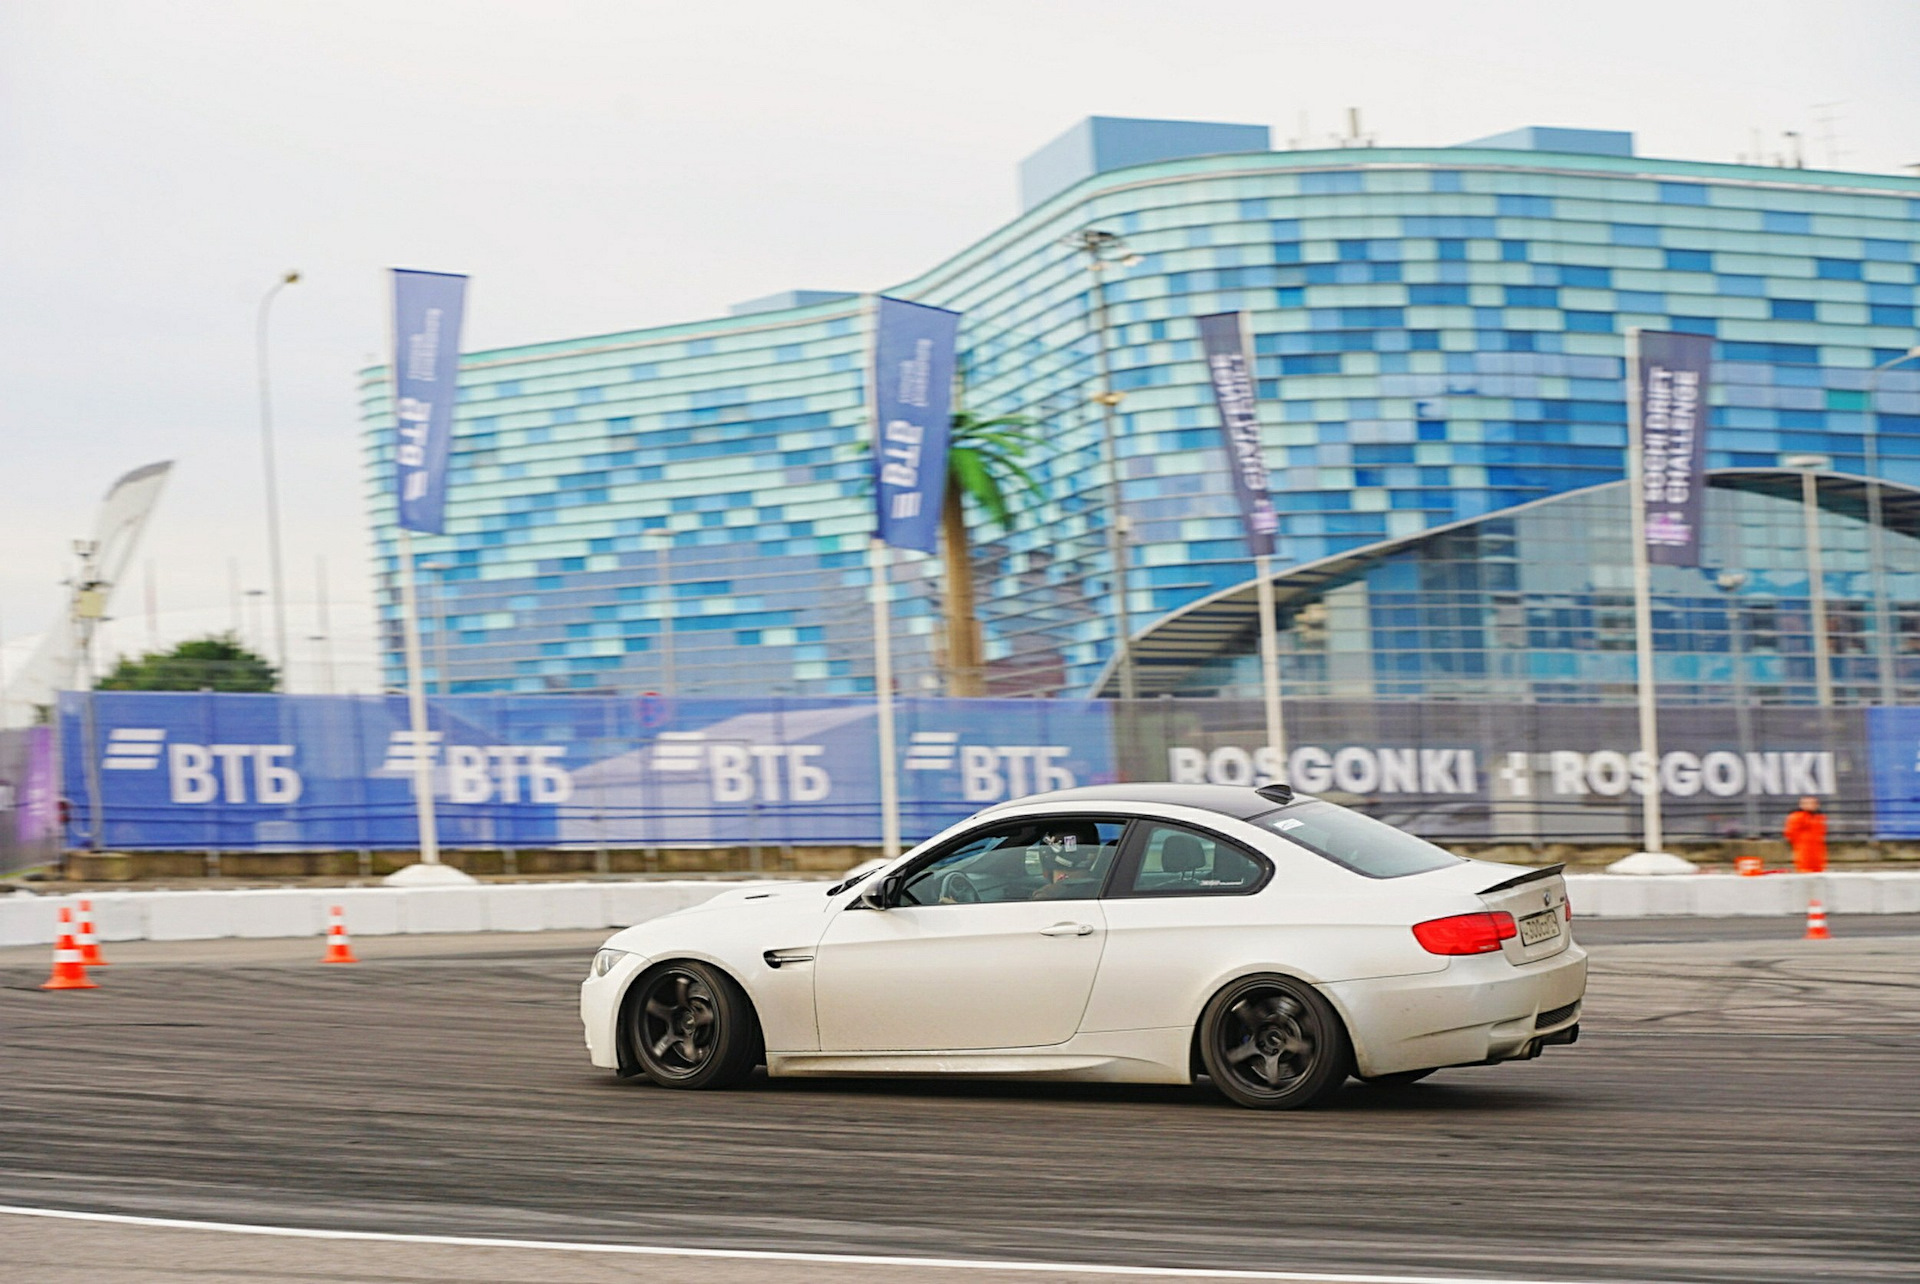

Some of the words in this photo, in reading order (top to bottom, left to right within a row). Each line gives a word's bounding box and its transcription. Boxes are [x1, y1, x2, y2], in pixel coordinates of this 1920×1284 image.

[1665, 371, 1699, 503] CHALLENGE
[168, 743, 302, 804] ВТБ
[445, 744, 573, 804] ВТБ
[707, 744, 831, 803] ВТБ
[960, 745, 1077, 801] ВТБ
[1168, 746, 1478, 794] ROSGONKI
[1550, 750, 1836, 796] ROSGONKI
